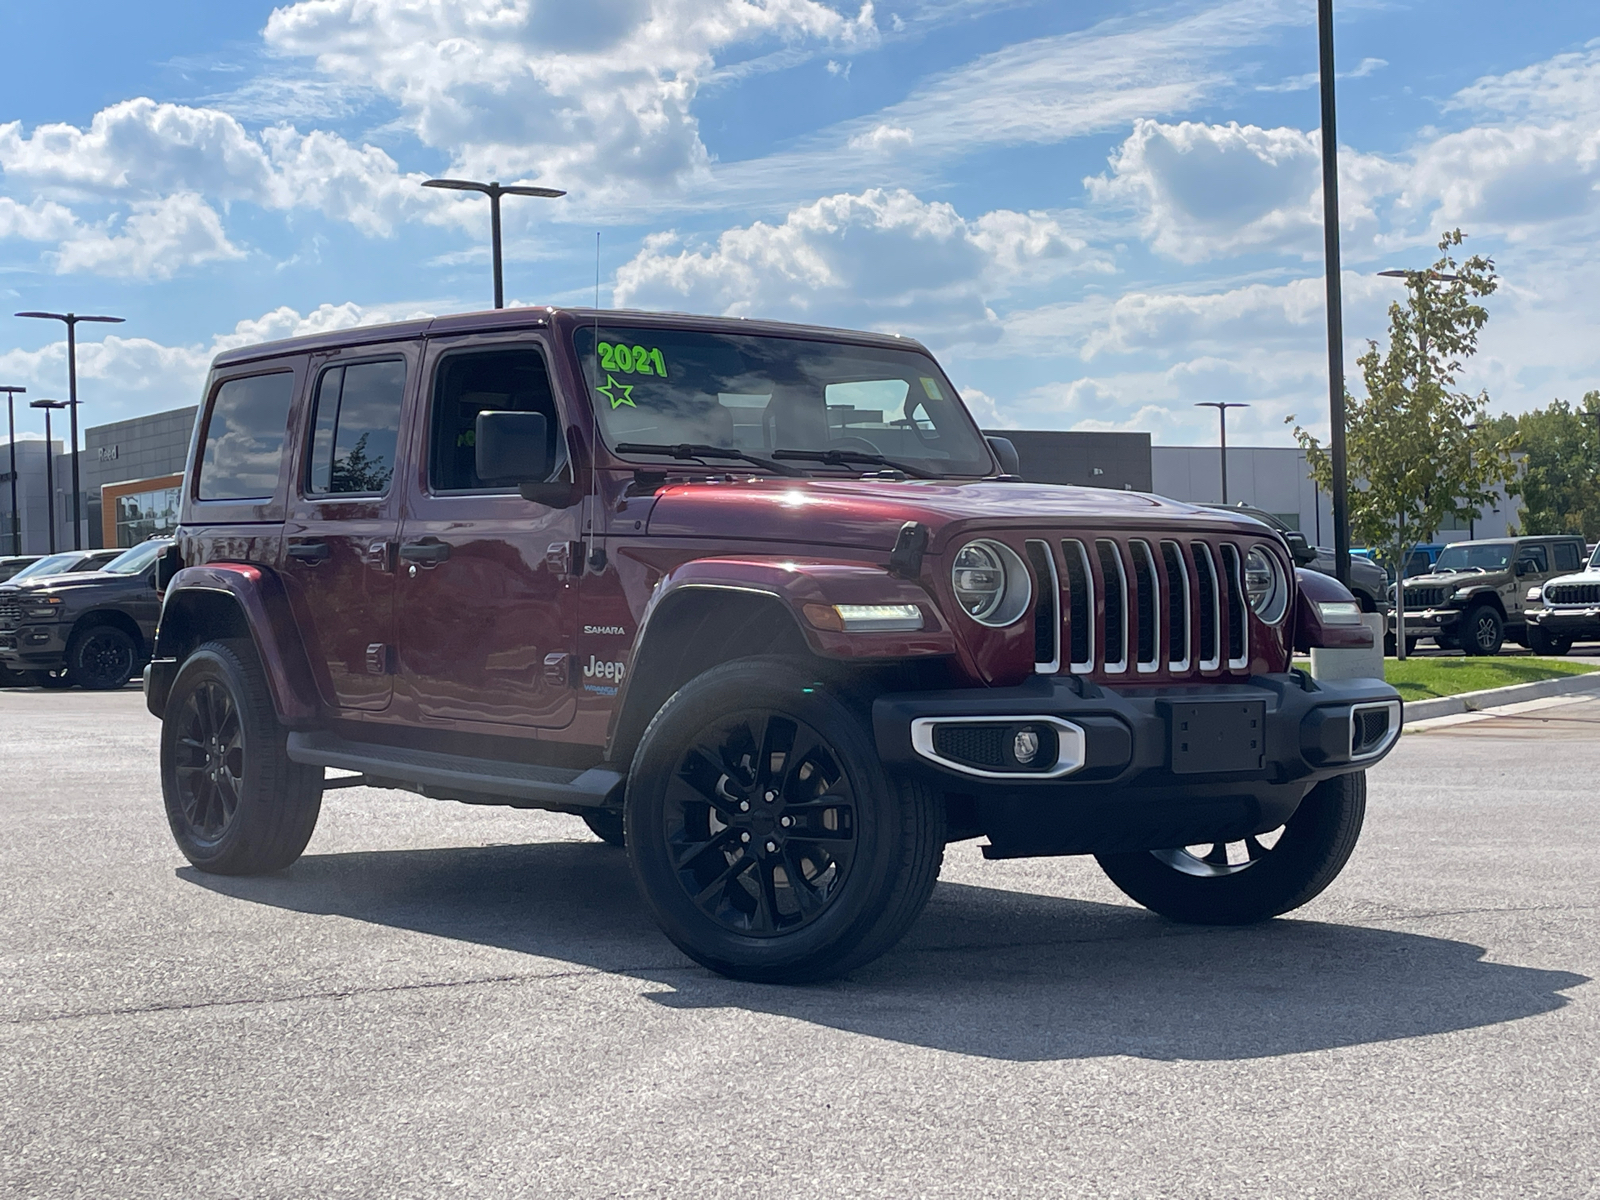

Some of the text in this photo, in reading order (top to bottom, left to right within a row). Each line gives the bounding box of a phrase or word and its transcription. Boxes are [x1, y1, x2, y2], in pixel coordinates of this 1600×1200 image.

[598, 342, 667, 377] 2021
[99, 445, 119, 461] Reed
[583, 625, 625, 635] SAHARA
[583, 655, 626, 683] Jeep
